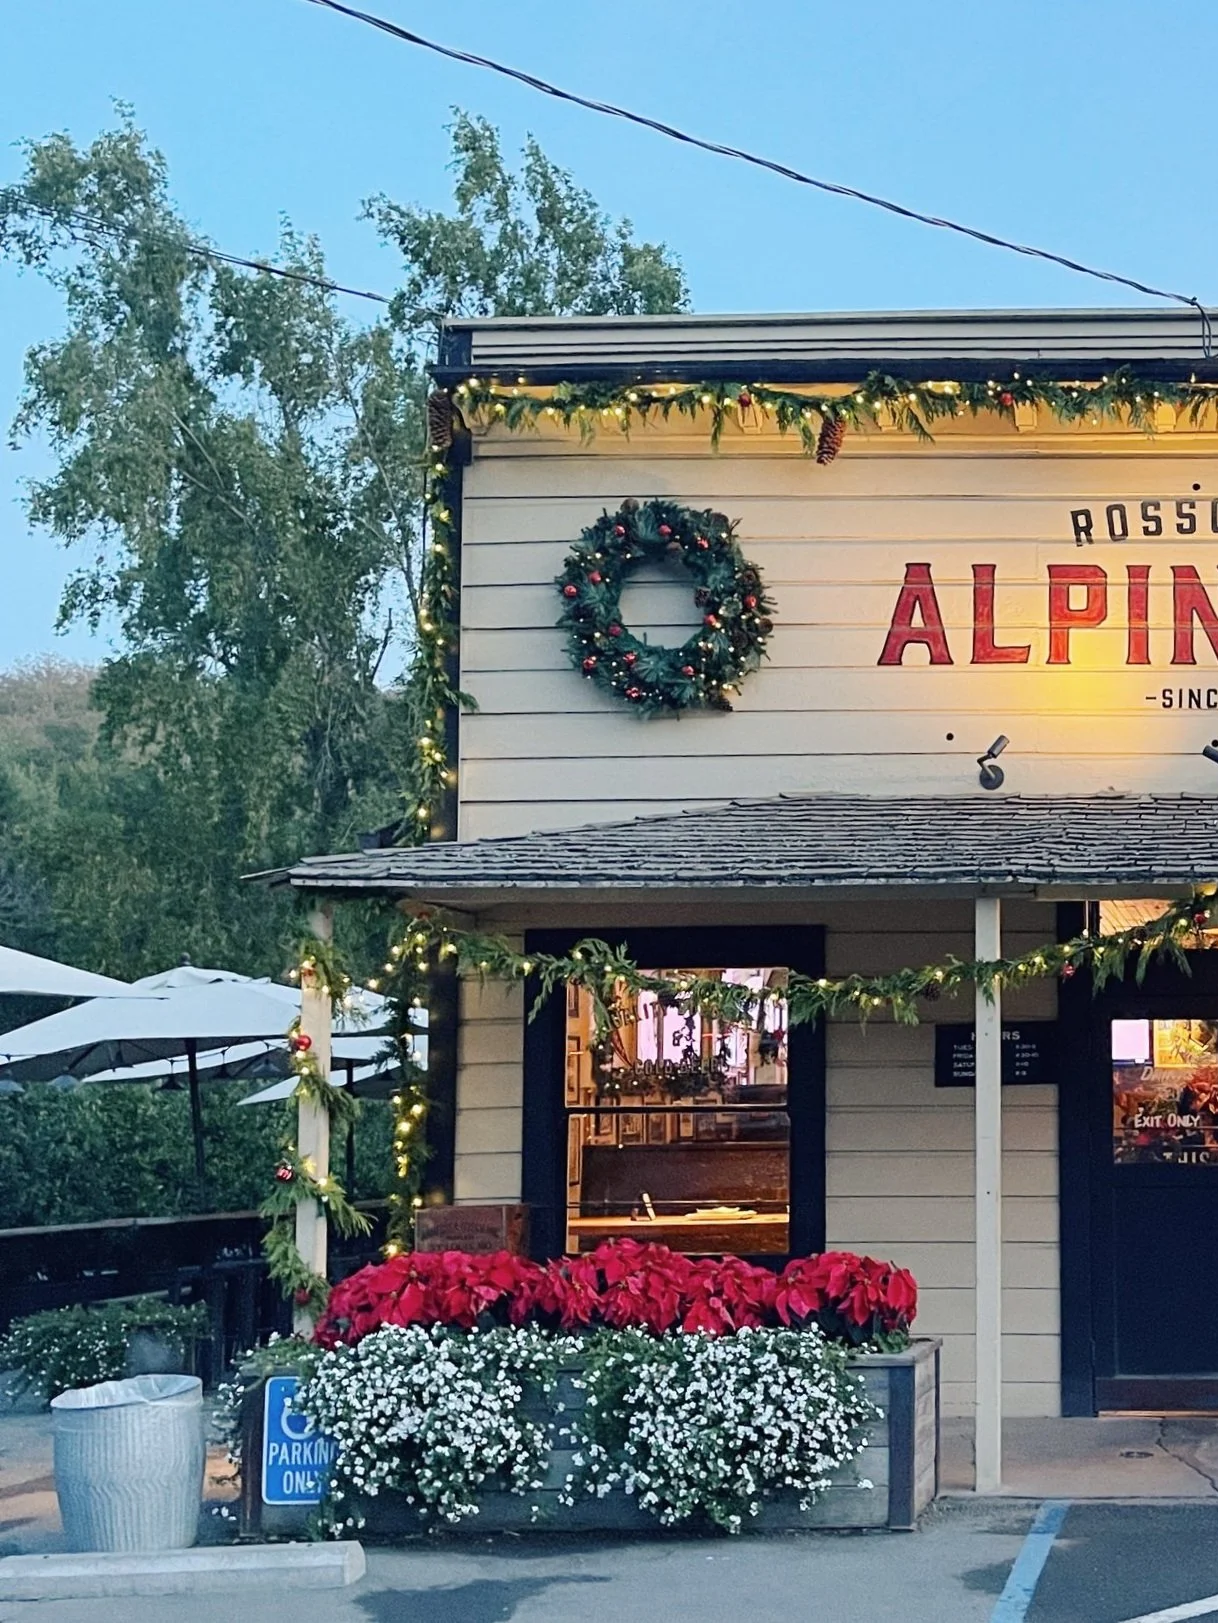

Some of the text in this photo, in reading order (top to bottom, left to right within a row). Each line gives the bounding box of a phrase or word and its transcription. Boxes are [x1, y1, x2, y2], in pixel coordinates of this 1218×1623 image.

[971, 1031, 1021, 1041] HRS
[1134, 1112, 1201, 1128] EXIT ONLY
